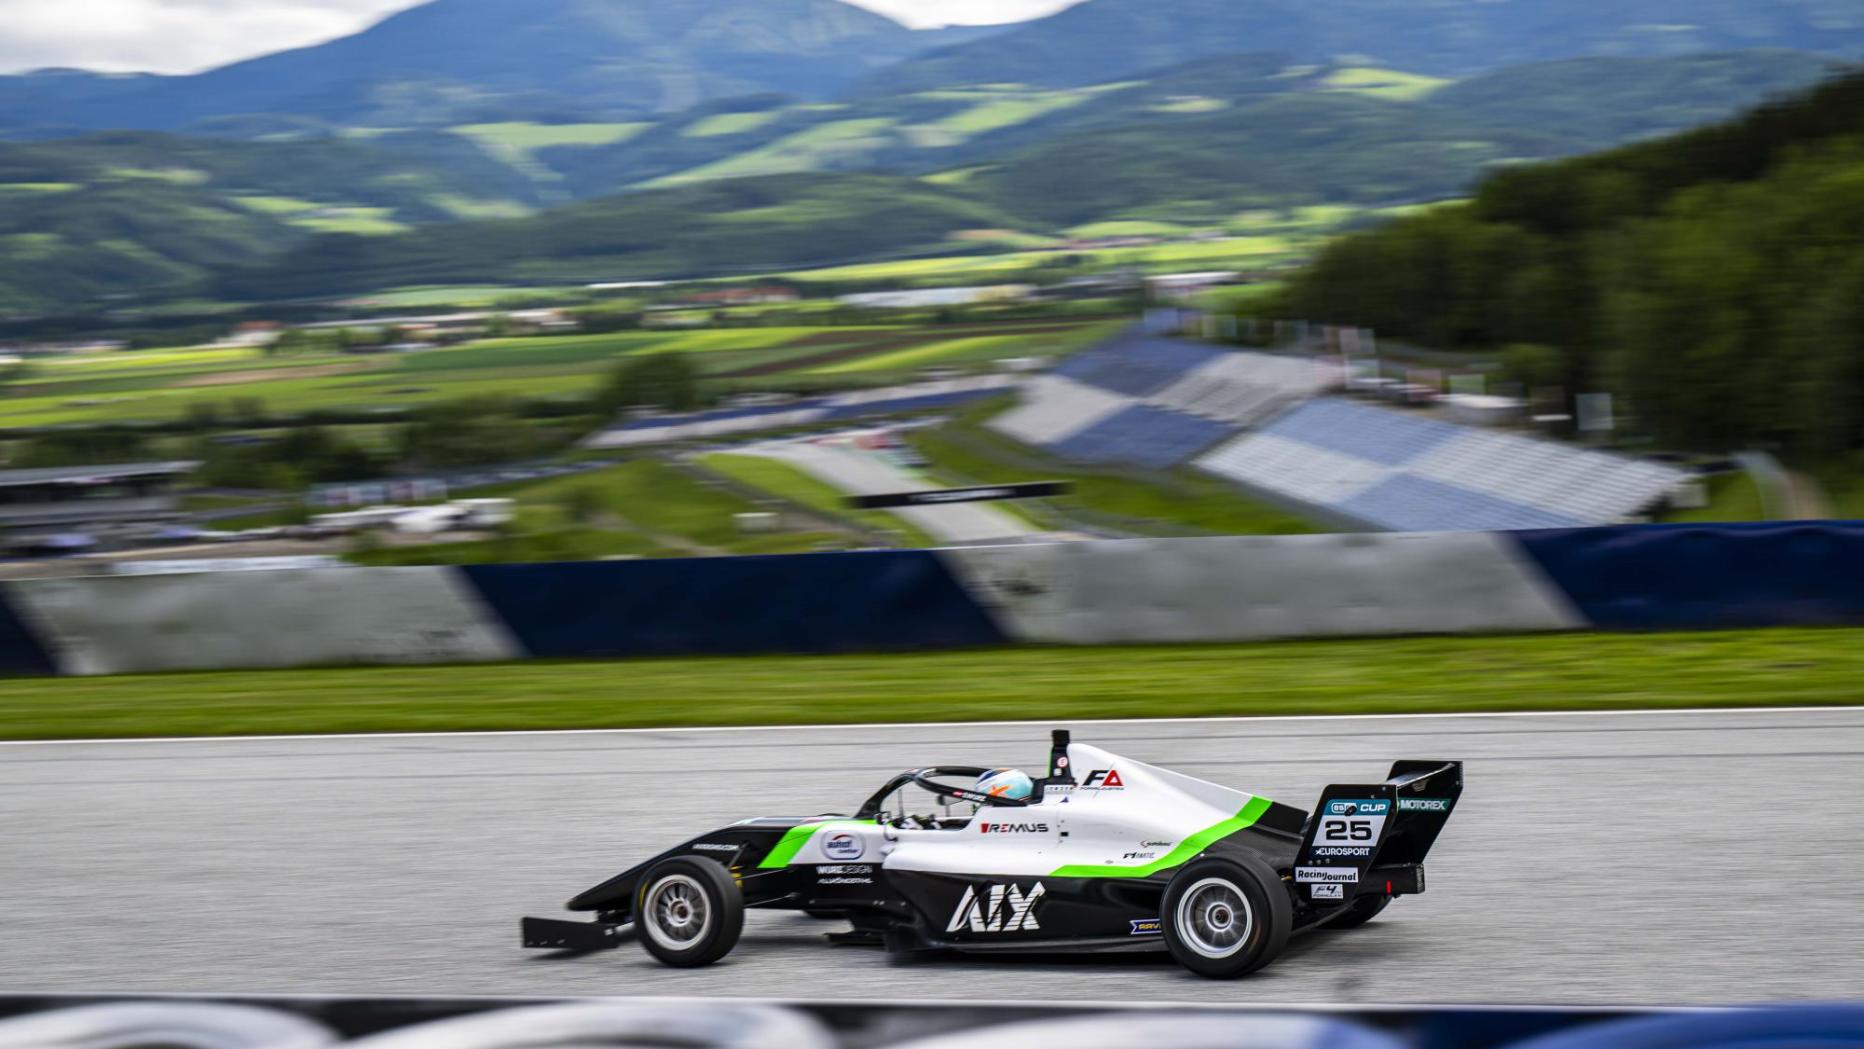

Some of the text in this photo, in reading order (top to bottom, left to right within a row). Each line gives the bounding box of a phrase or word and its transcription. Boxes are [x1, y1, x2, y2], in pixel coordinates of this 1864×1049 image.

[1360, 804, 1386, 812] CUP
[1400, 800, 1447, 810] MOTOREX
[988, 823, 1049, 833] REMUS
[1325, 821, 1371, 840] 25
[1318, 847, 1370, 856] EUROSPORT
[1316, 885, 1337, 893] F4
[945, 880, 1046, 932] AIX
